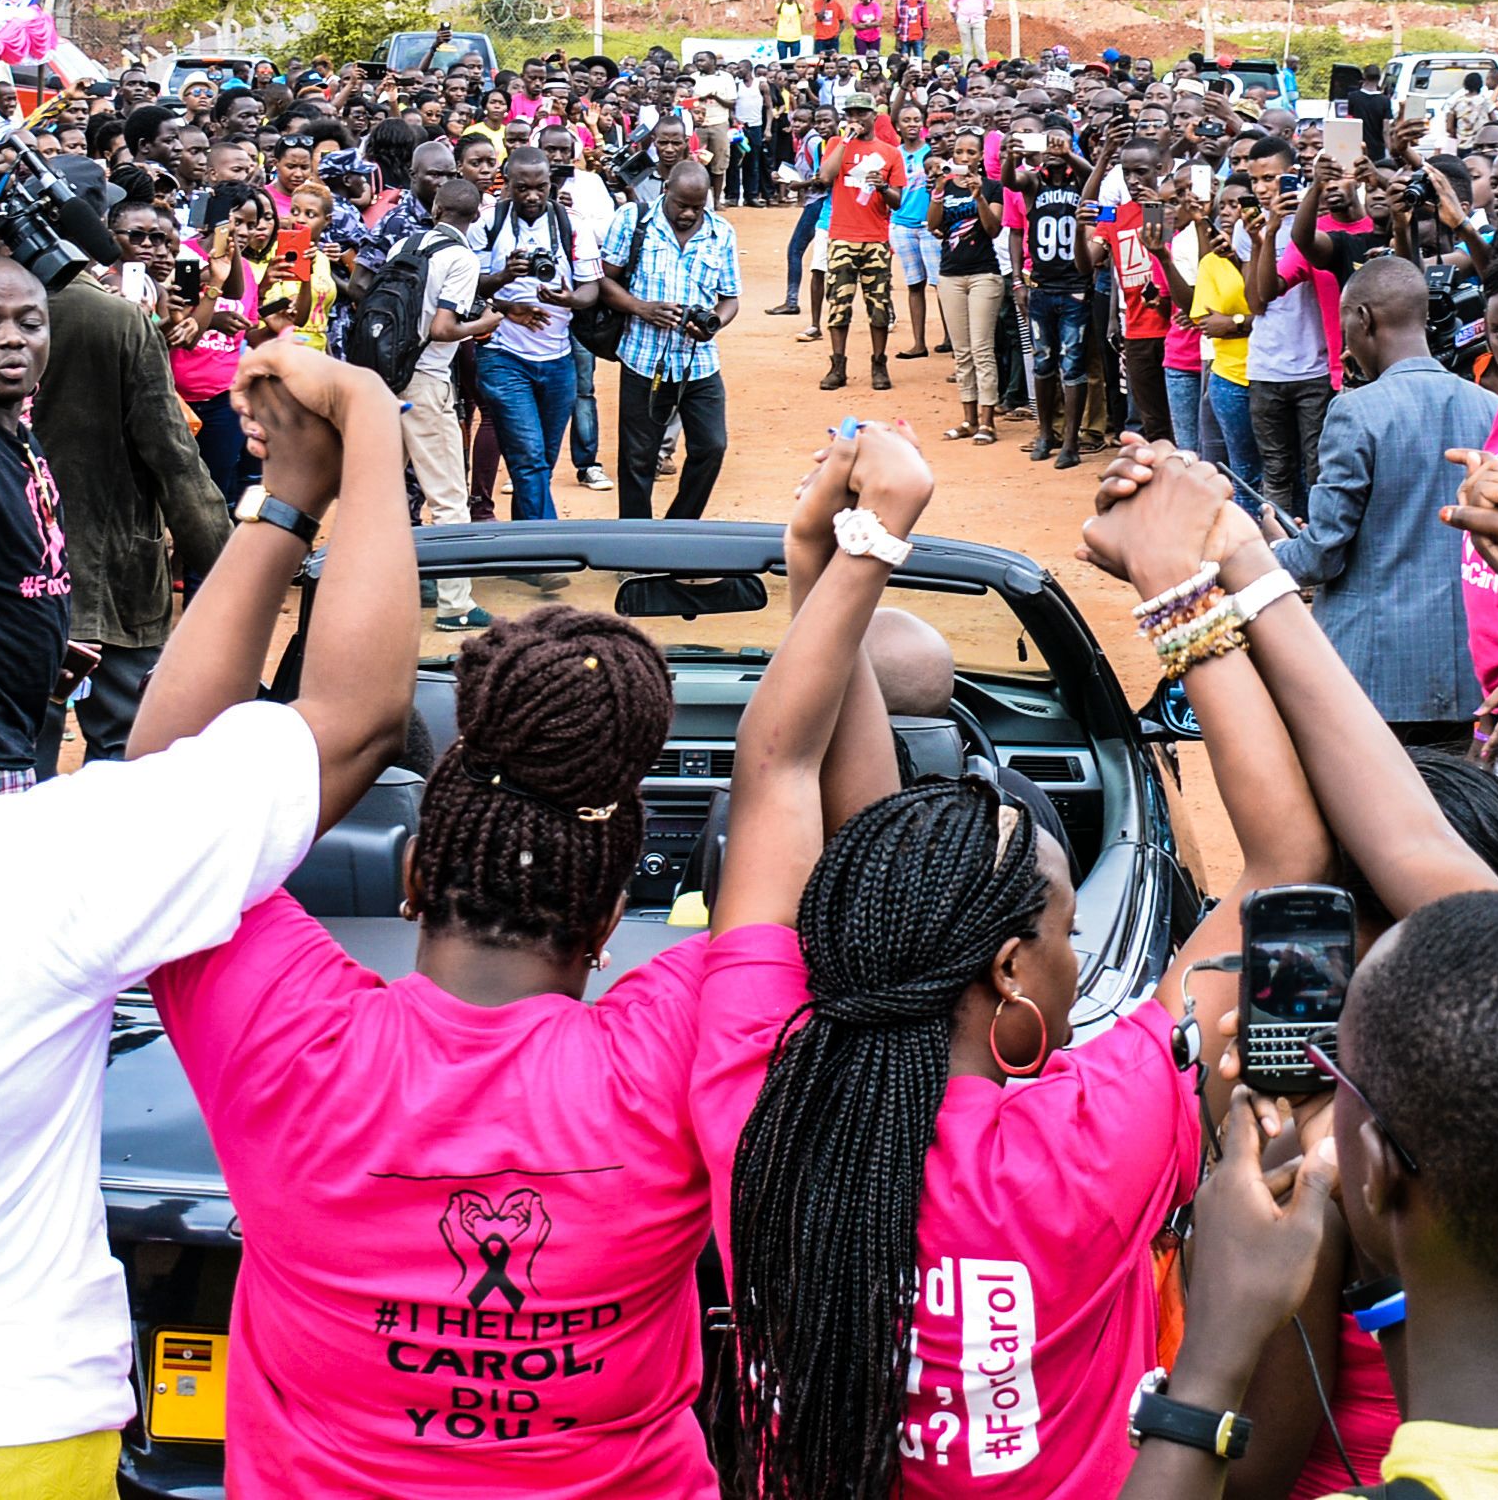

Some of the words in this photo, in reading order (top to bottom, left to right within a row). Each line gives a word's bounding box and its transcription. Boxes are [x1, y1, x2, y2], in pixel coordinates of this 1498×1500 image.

[1037, 215, 1077, 262] 99
[437, 1302, 622, 1341] HELPED
[387, 1340, 605, 1382] CAROL,
[977, 1274, 1024, 1460] #ForCarol
[451, 1387, 540, 1414] DID
